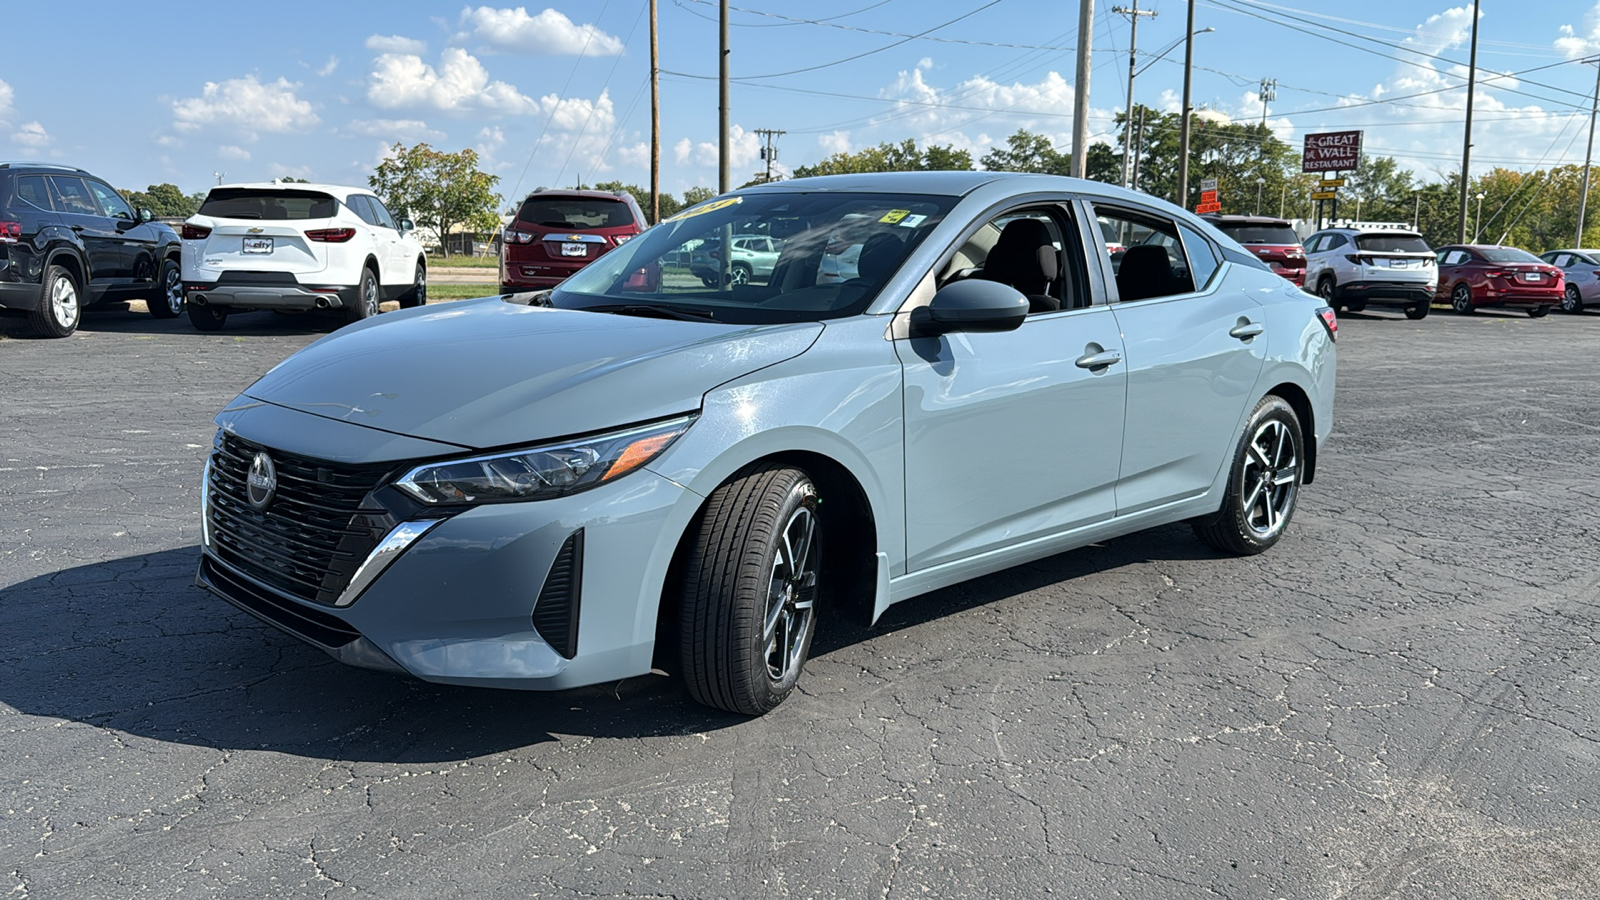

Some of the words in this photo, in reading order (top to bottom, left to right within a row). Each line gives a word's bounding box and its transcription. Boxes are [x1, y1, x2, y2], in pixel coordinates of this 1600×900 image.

[1318, 134, 1357, 147] GREAT
[1318, 146, 1354, 158] WALL
[1304, 159, 1356, 169] RESTAURANT
[1202, 181, 1216, 189] TRUCK
[248, 474, 276, 489] SSAN
